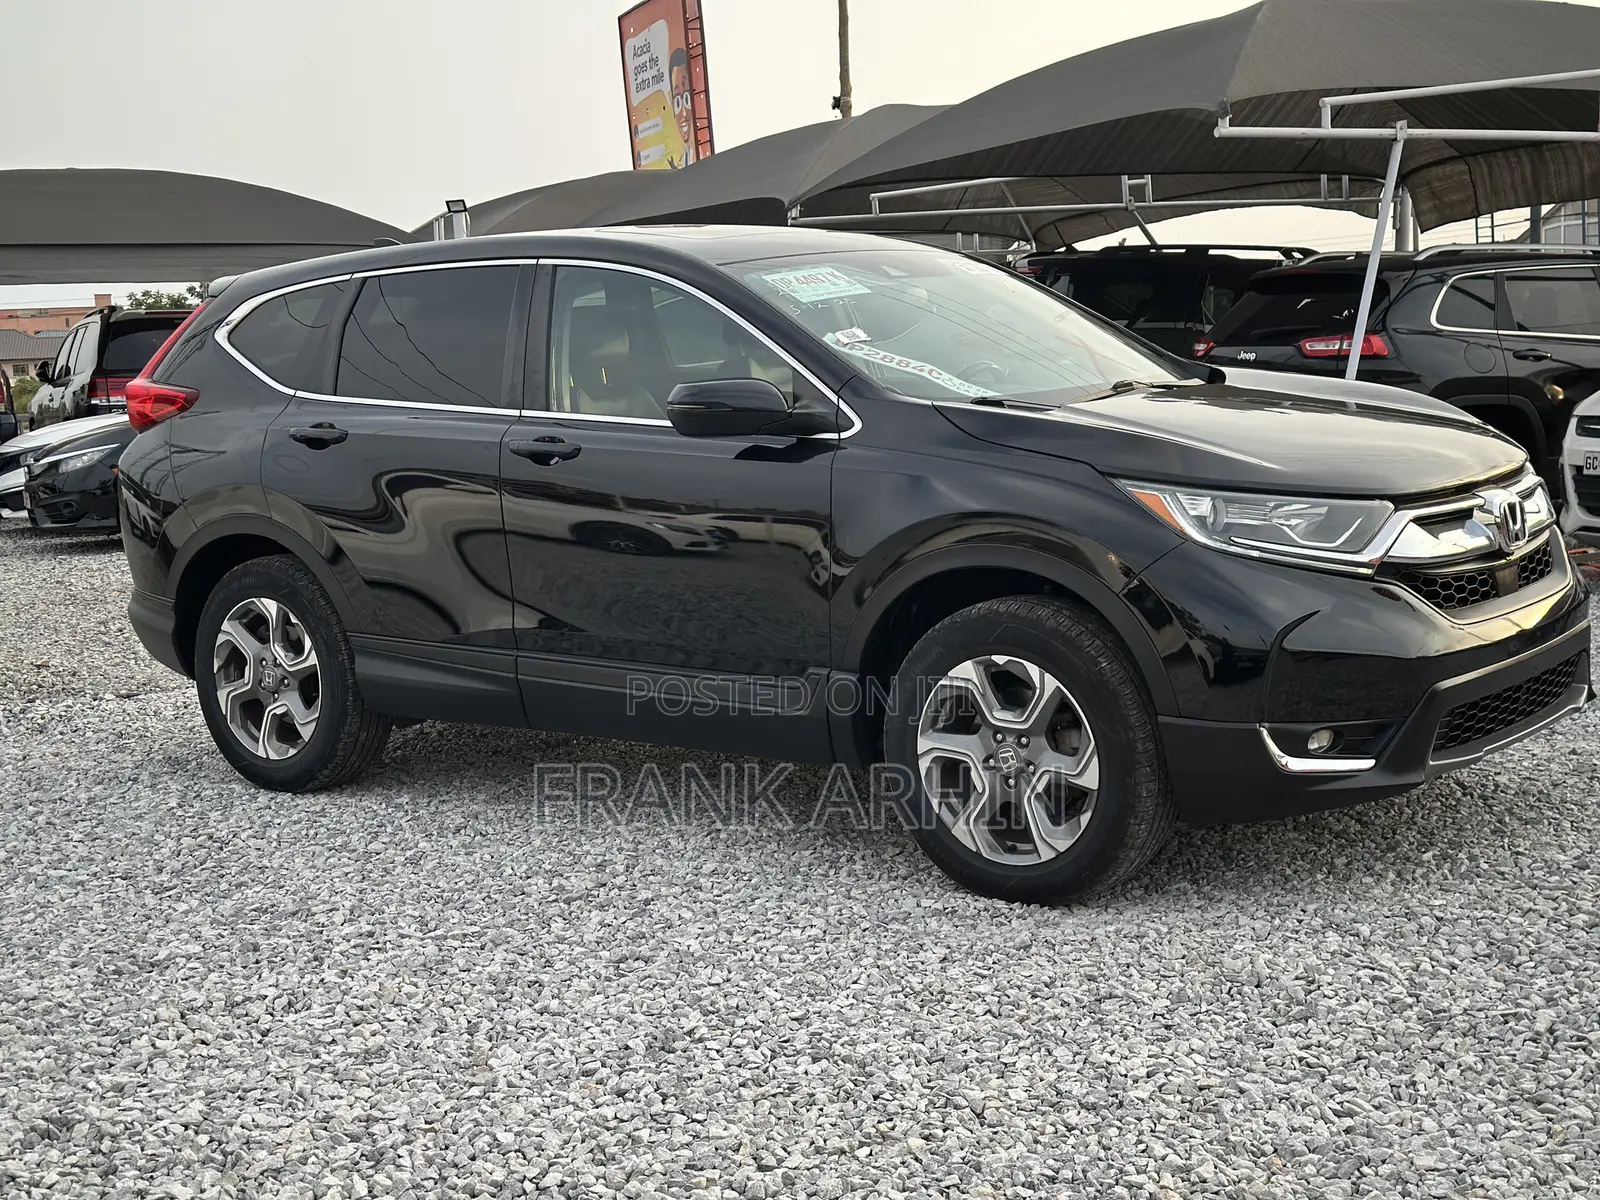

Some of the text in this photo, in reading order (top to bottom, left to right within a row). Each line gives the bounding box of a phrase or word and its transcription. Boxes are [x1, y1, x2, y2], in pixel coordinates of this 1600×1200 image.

[632, 38, 651, 60] Acacia
[633, 53, 660, 81] goes the
[635, 67, 665, 93] extra mile
[1237, 350, 1257, 362] Jeep
